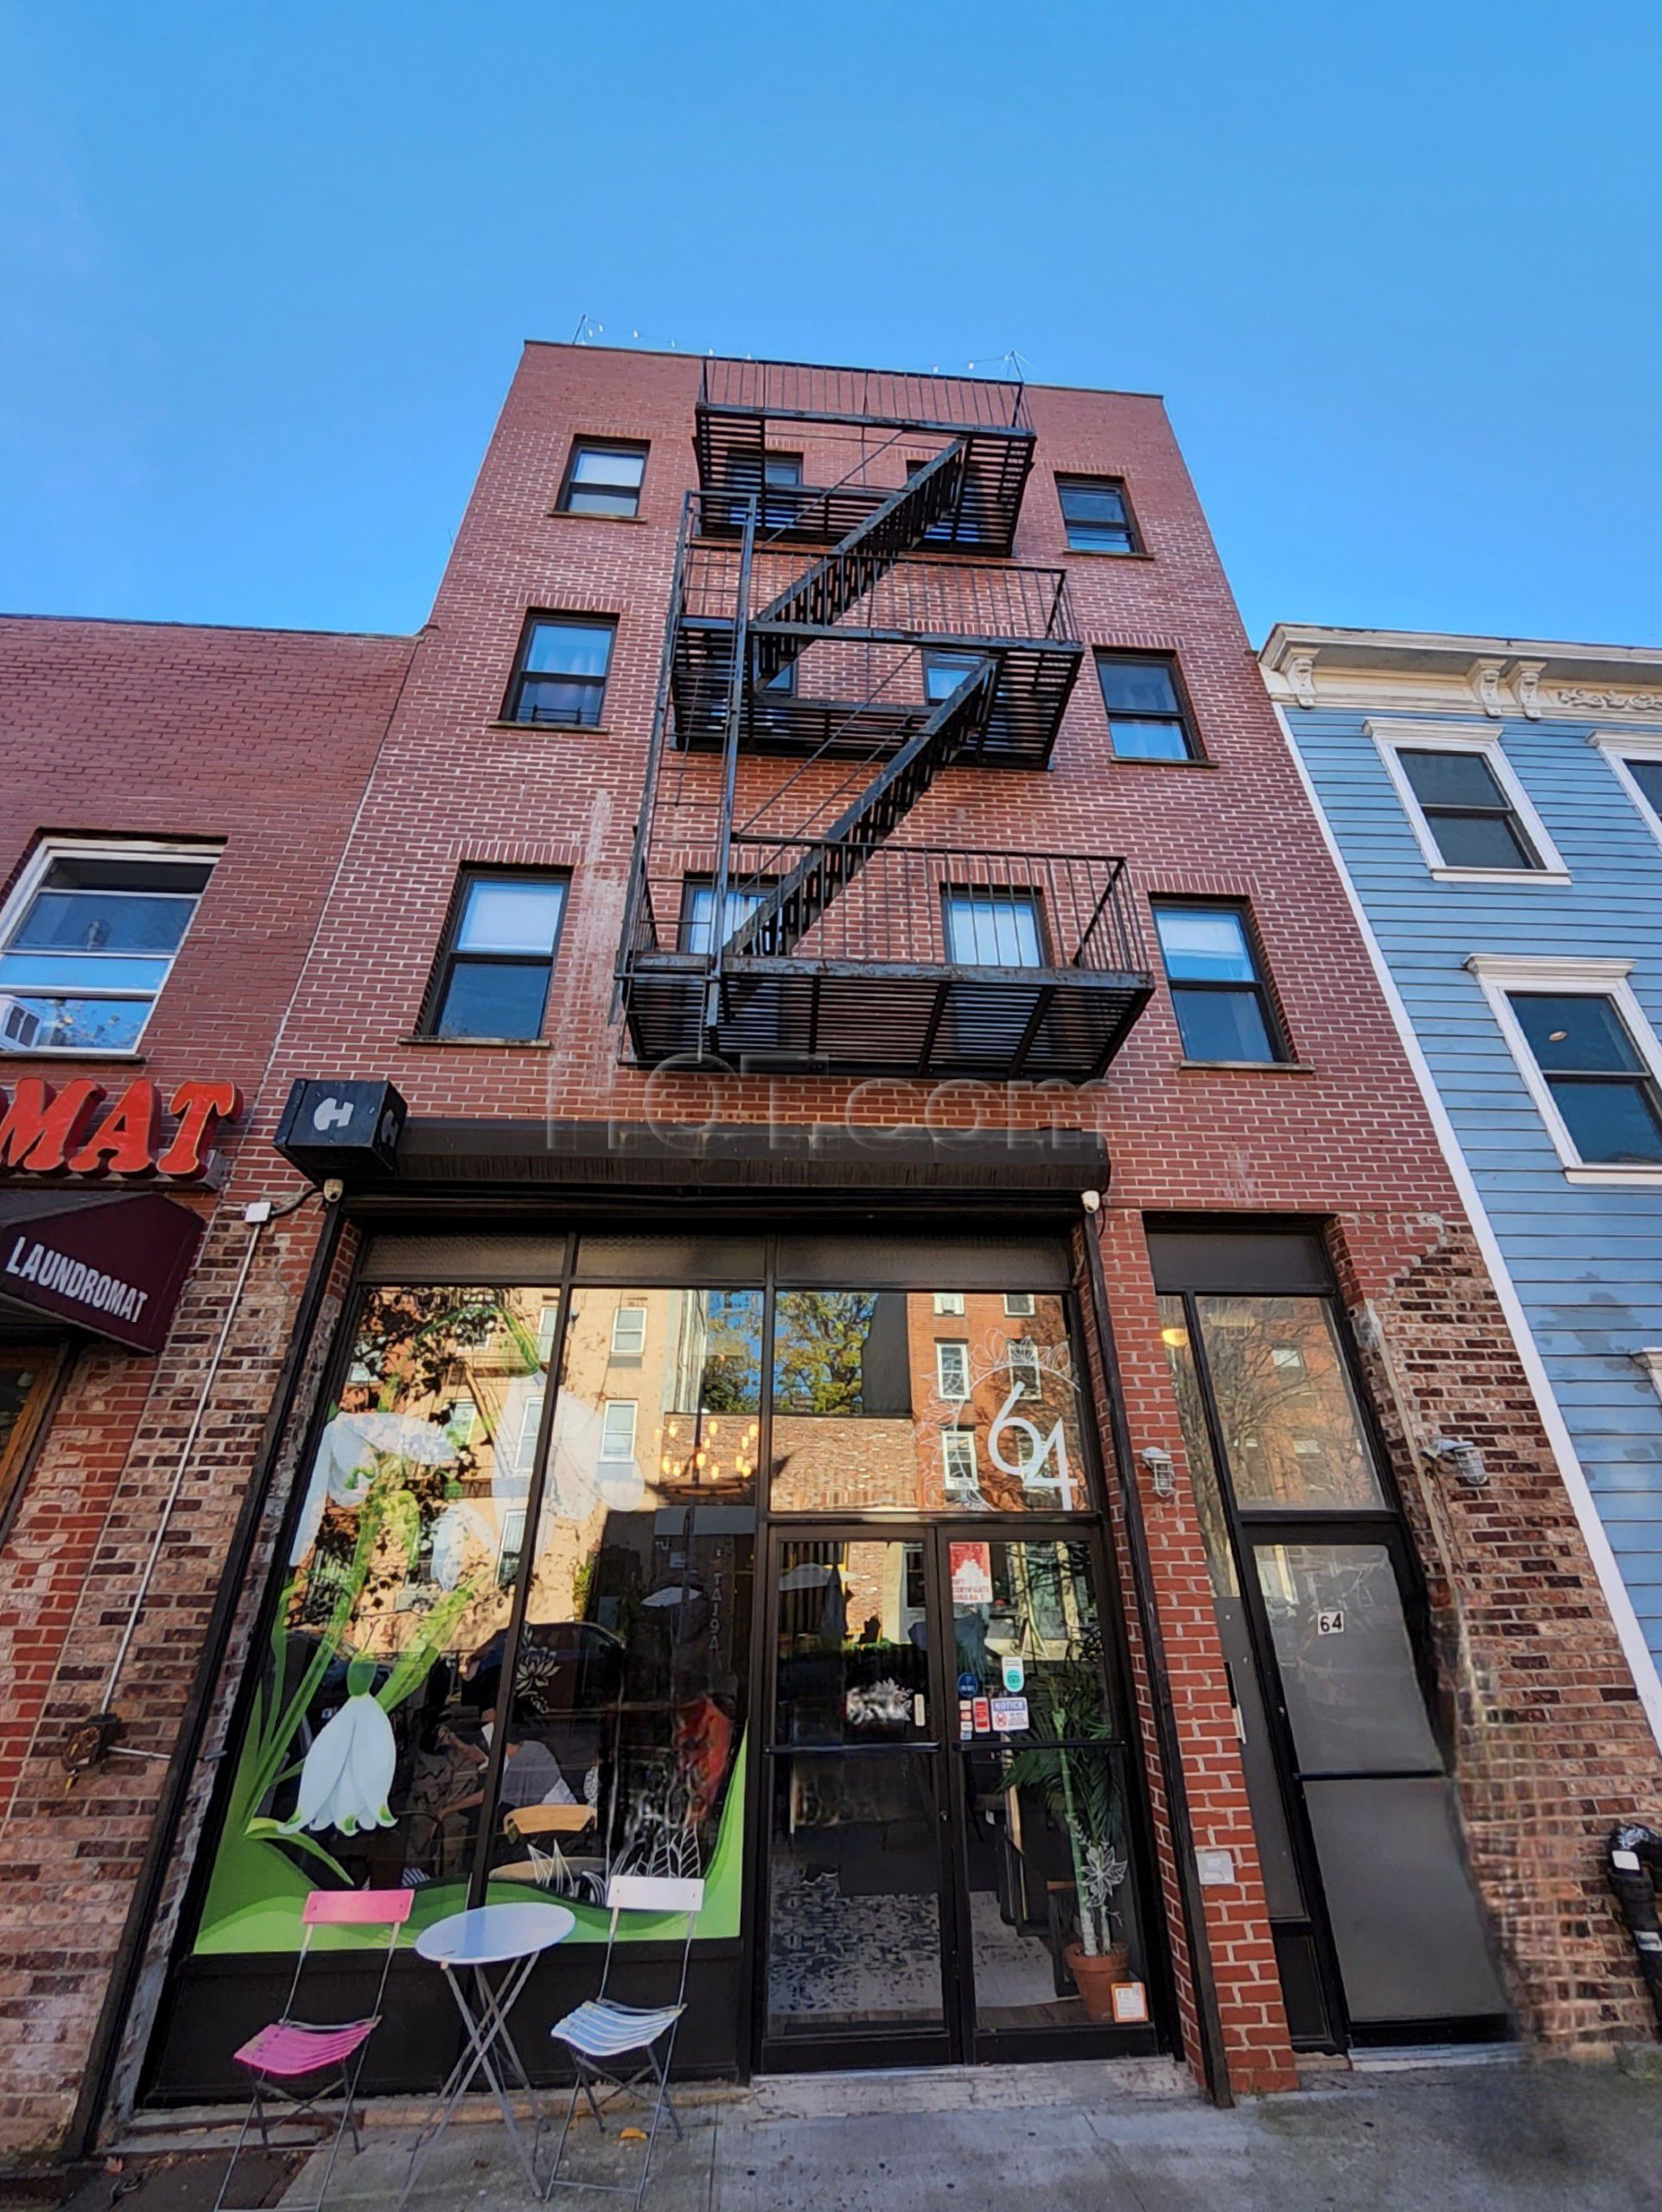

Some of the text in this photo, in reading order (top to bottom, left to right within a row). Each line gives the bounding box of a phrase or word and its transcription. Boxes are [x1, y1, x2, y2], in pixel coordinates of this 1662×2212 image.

[6, 1236, 149, 1323] LAUNDROMAT
[988, 1381, 1078, 1510] 64
[1320, 1612, 1342, 1633] 64
[994, 1700, 1023, 1710] NOTICE
